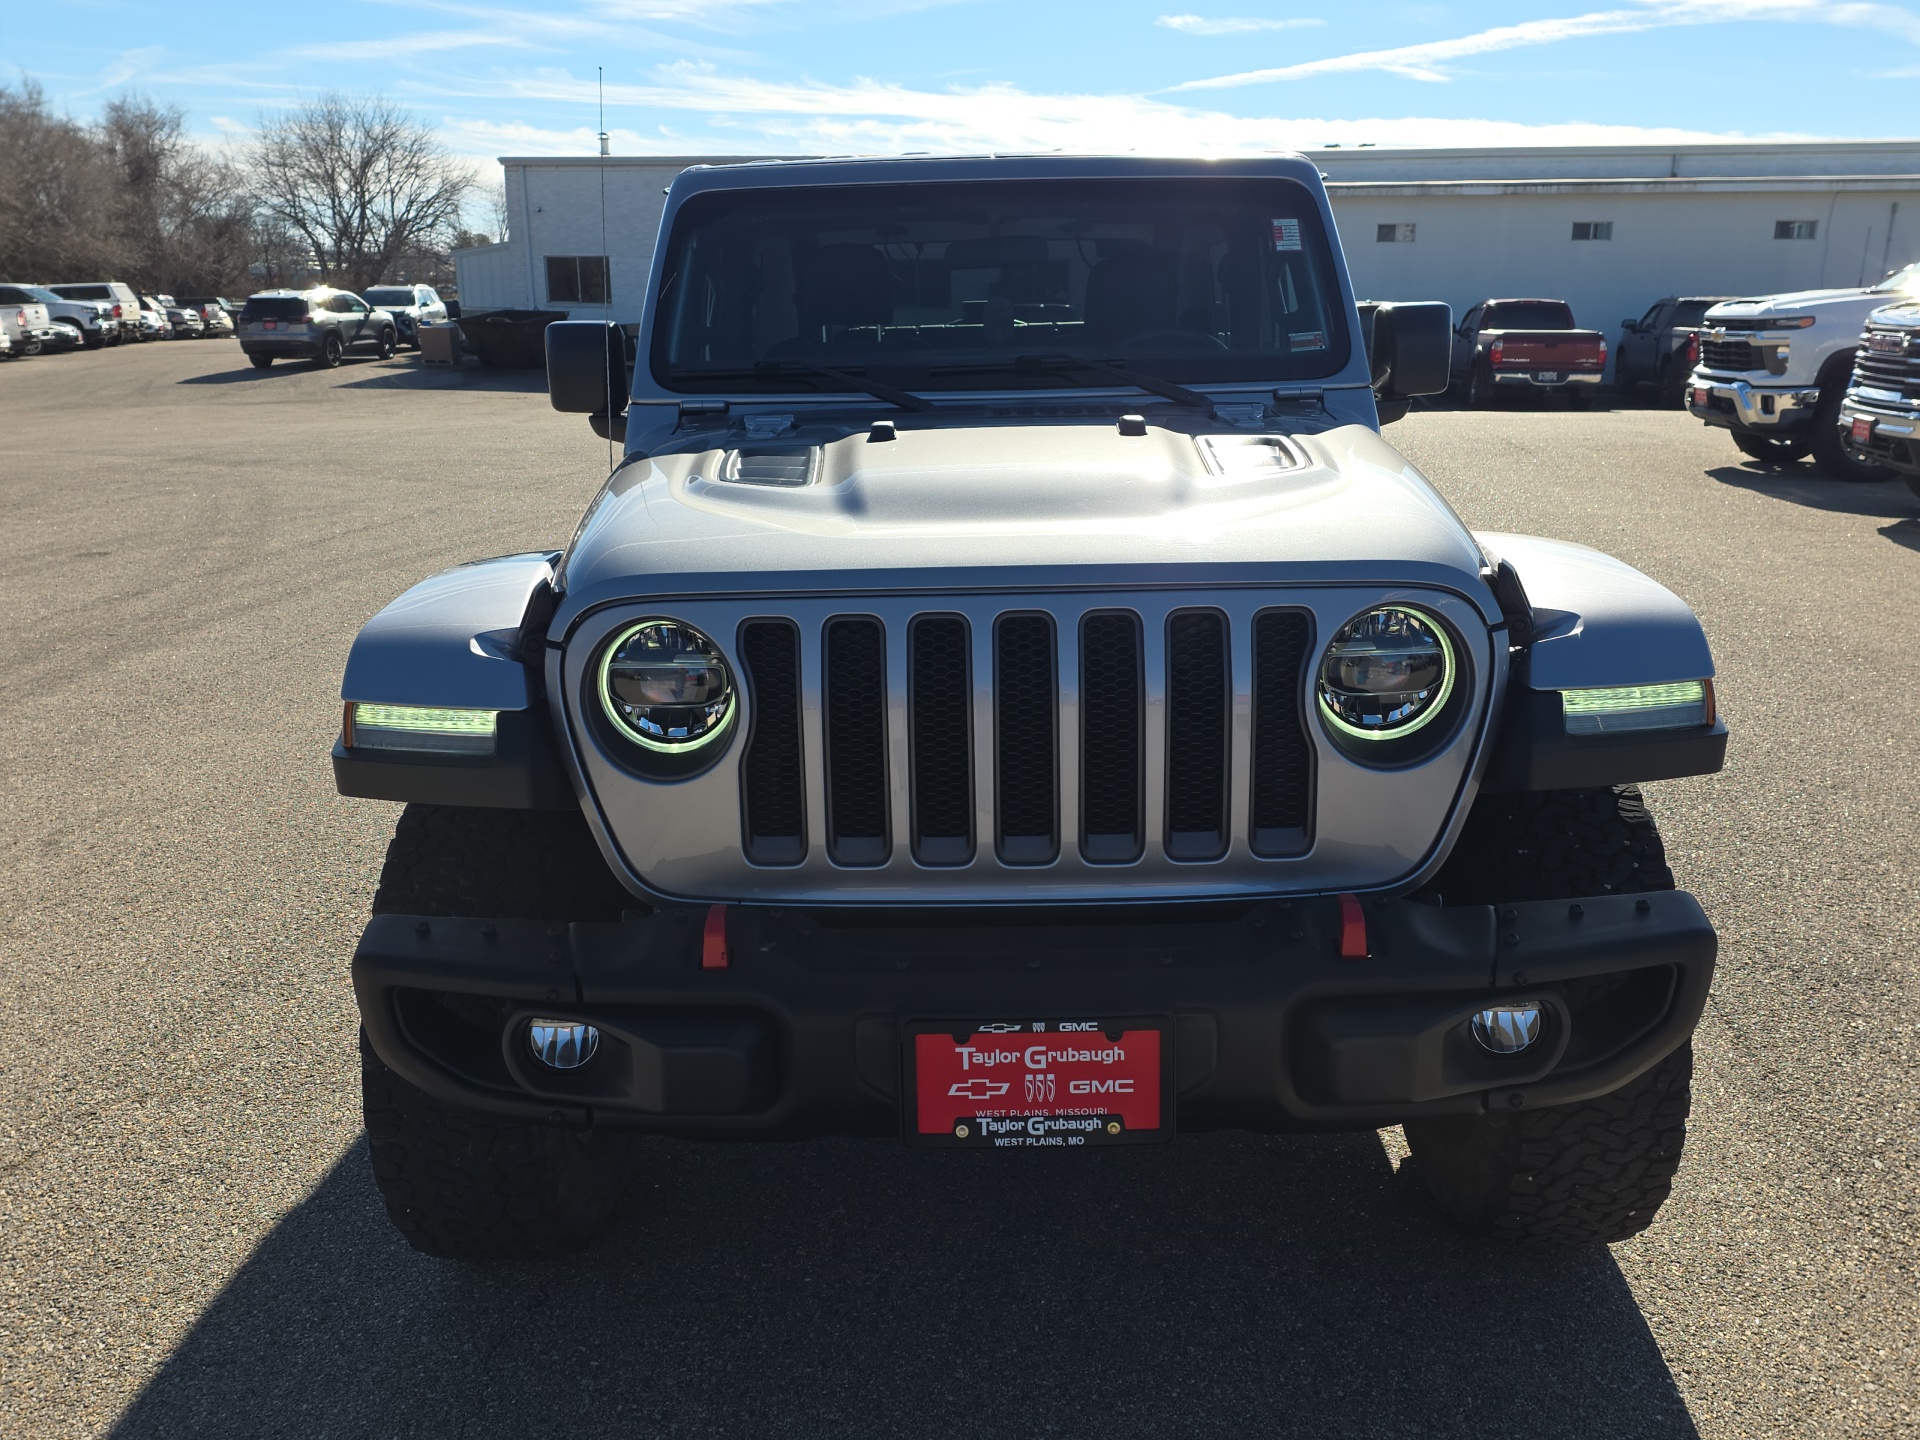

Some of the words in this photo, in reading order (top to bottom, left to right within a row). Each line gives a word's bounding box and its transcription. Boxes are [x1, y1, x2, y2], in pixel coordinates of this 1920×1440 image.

[1059, 1022, 1098, 1032] GMC
[955, 1047, 1020, 1070] Taylor
[1024, 1046, 1125, 1069] Grubaugh
[1069, 1079, 1134, 1094] GMC
[975, 1109, 1006, 1118] WEST
[1055, 1107, 1108, 1116] MISSOURI
[976, 1118, 1025, 1136] Taylor
[1027, 1117, 1102, 1135] Grubaugh
[994, 1138, 1024, 1147] WEST
[1026, 1137, 1066, 1147] PLAINS,
[1068, 1136, 1085, 1146] MO
